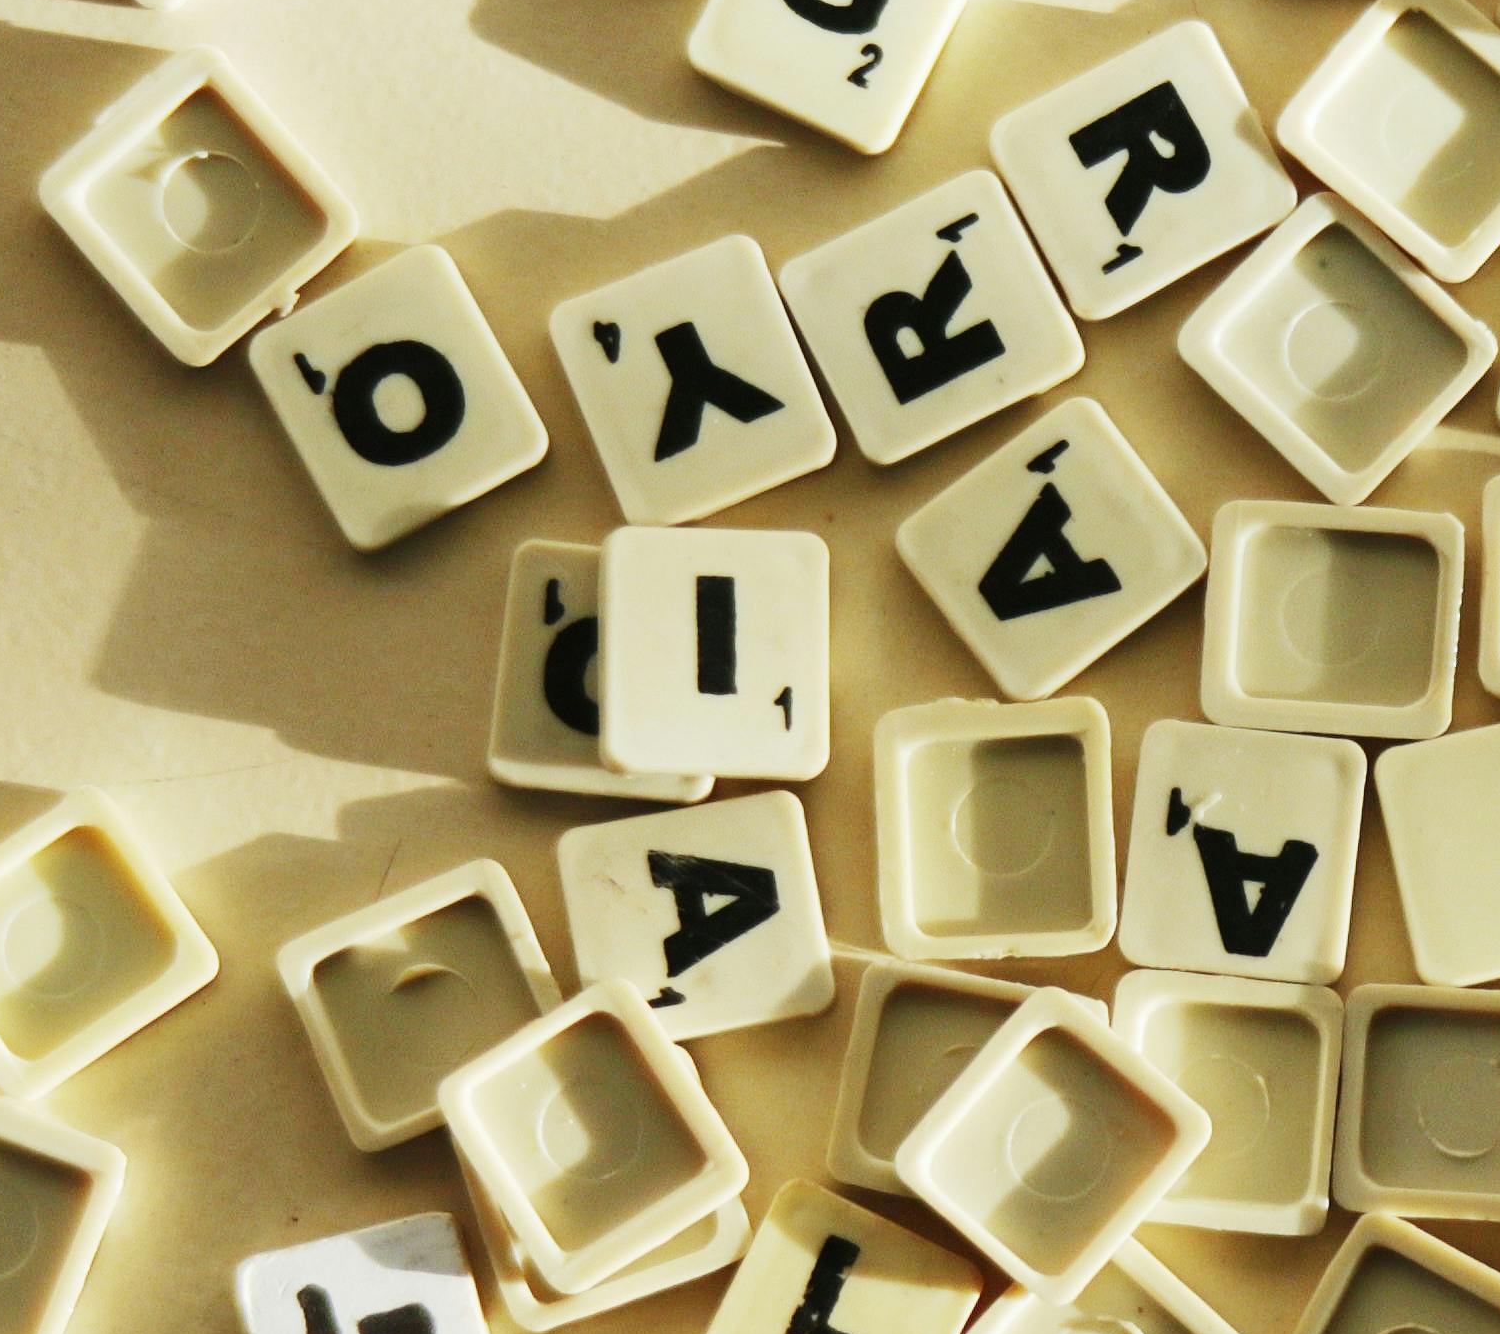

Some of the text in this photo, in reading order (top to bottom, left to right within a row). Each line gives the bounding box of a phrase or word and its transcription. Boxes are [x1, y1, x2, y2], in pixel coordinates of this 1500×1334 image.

[847, 44, 882, 88] 2
[1069, 81, 1211, 274] R 1
[864, 213, 1005, 405] R 1
[294, 340, 465, 466] O 1
[654, 322, 785, 462] Y
[978, 440, 1122, 621] A 1
[696, 576, 792, 730] I 1
[647, 850, 780, 978] A
[1166, 787, 1318, 957] A 1
